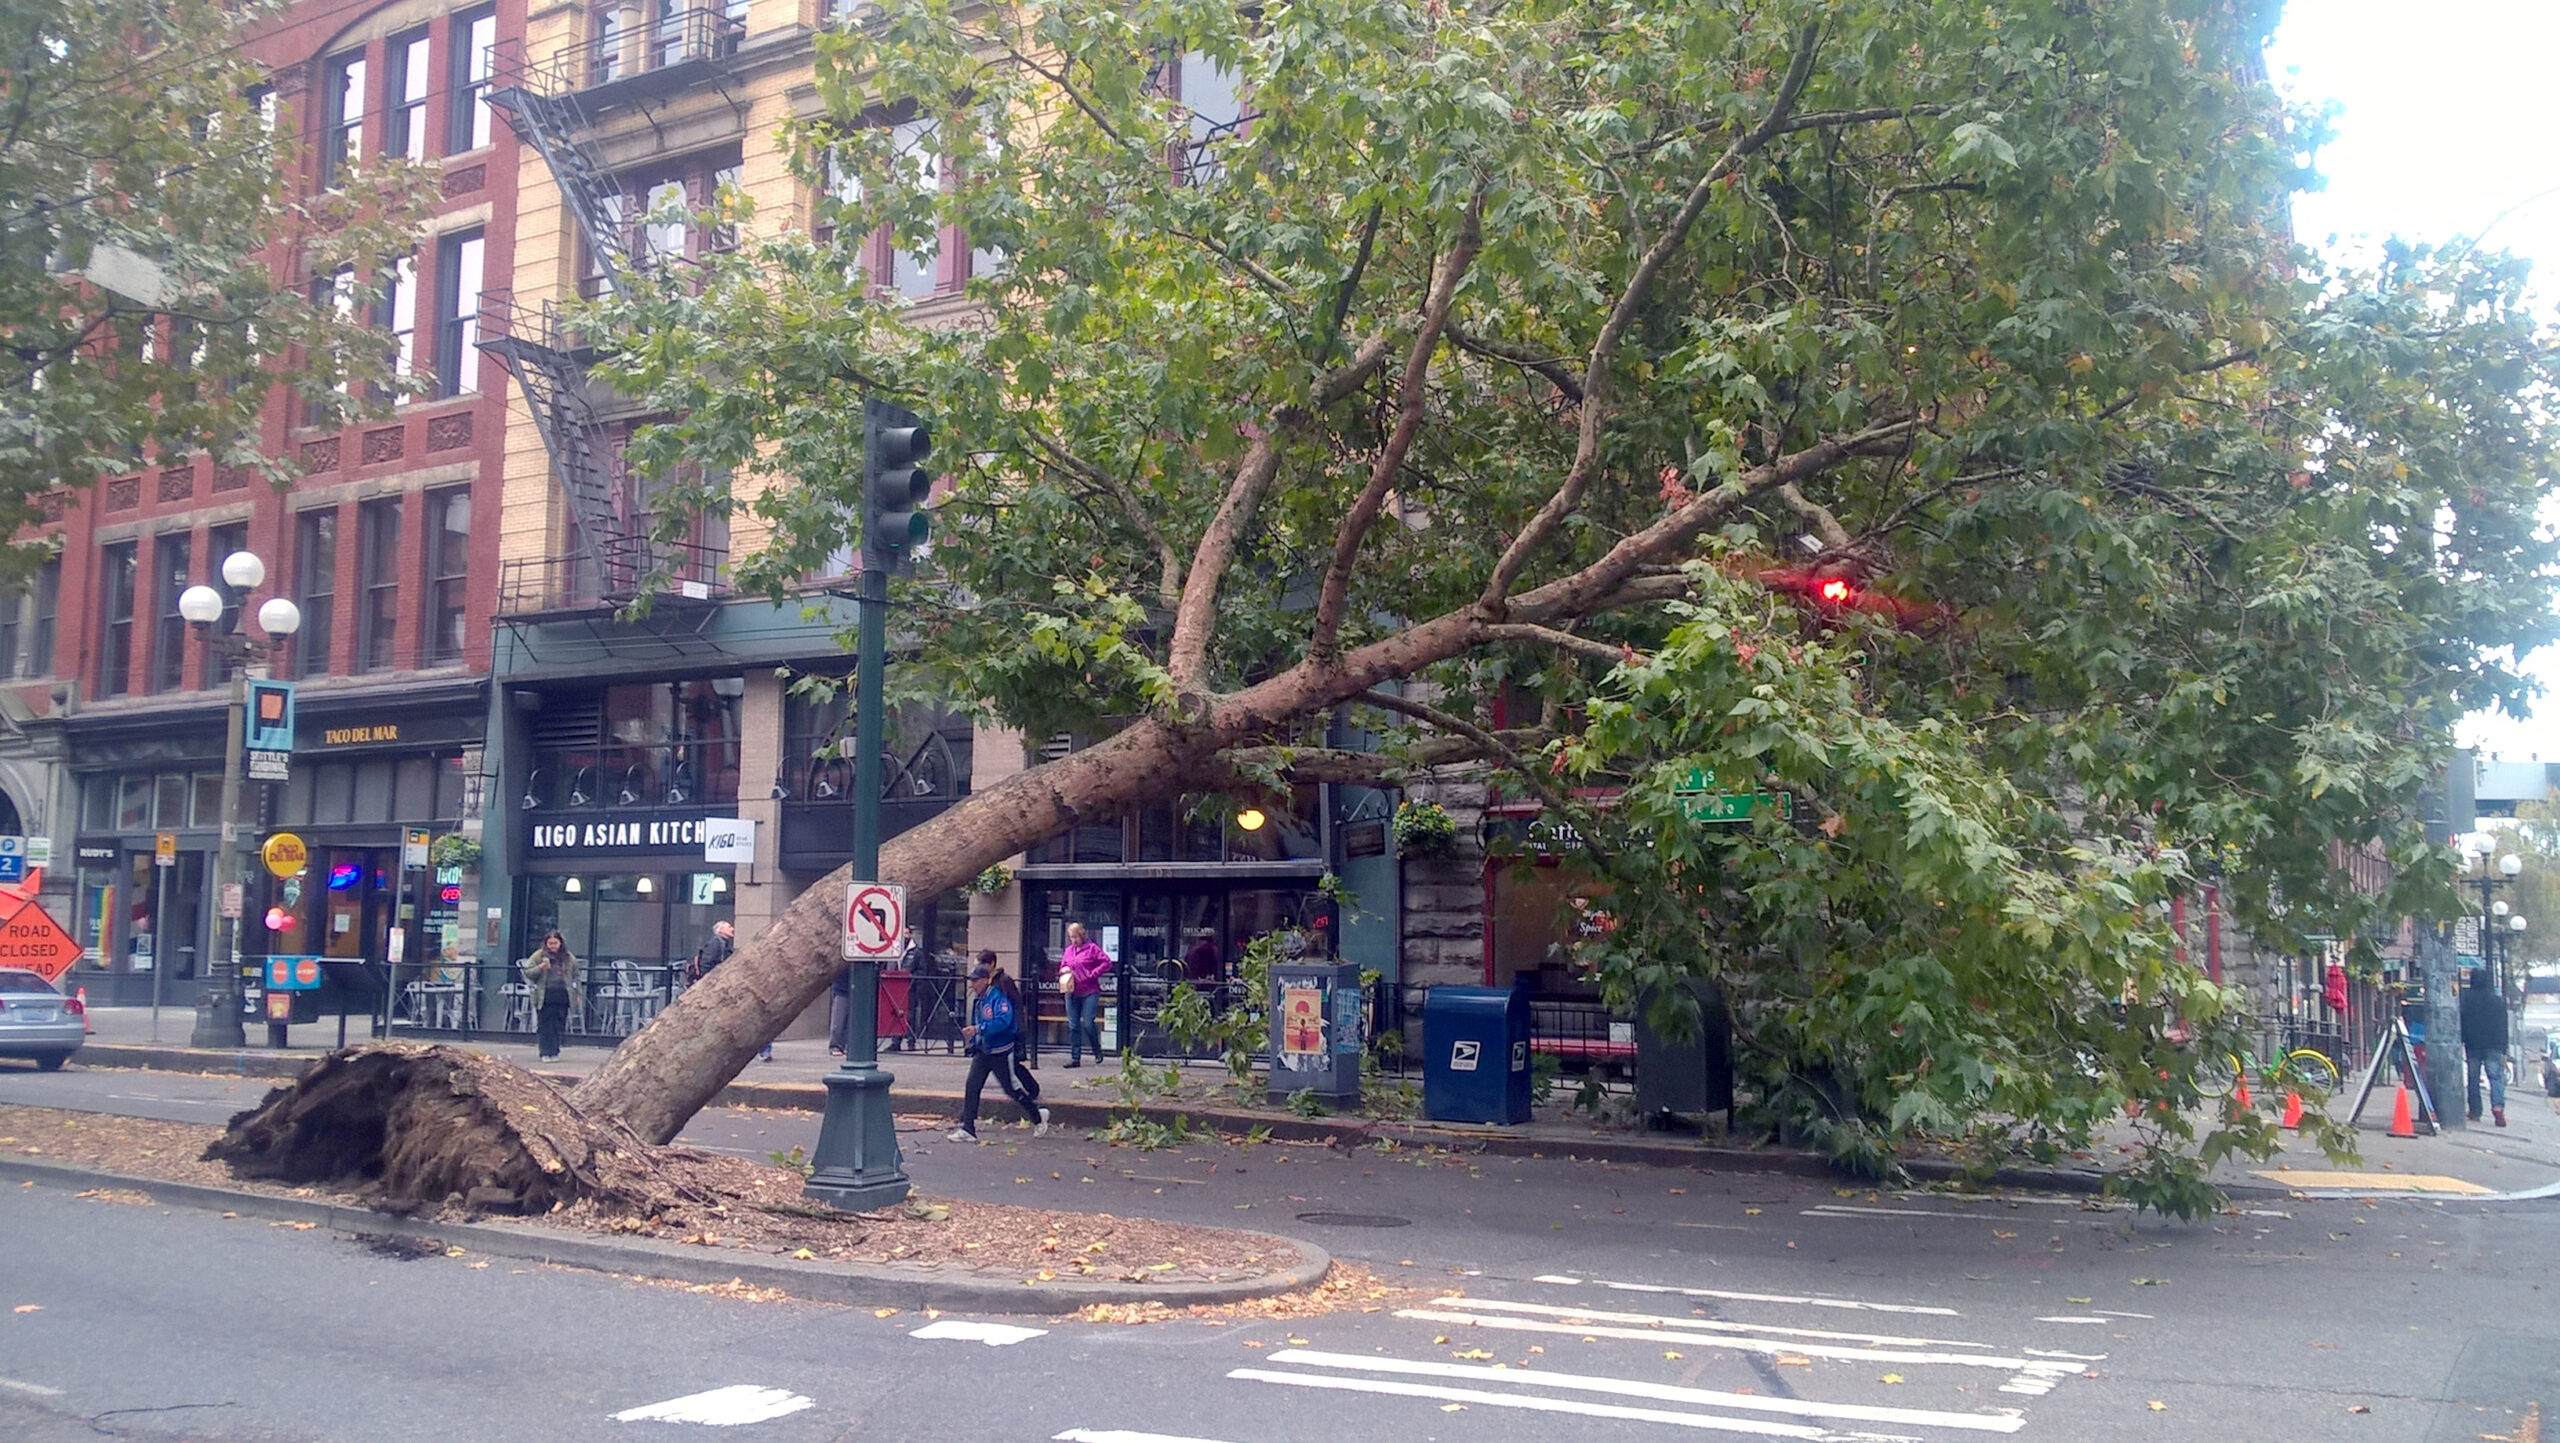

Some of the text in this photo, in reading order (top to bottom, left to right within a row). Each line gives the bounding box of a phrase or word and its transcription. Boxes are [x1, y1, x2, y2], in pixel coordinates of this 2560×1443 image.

[325, 725, 398, 744] TACO DEL MAR
[533, 820, 705, 847] KIGO ASIAN KITCH
[708, 833, 735, 849] KIGO
[79, 848, 115, 858] RUDY'S
[0, 857, 12, 871] 2
[9, 925, 50, 938] ROAD
[0, 944, 58, 958] CLOSED
